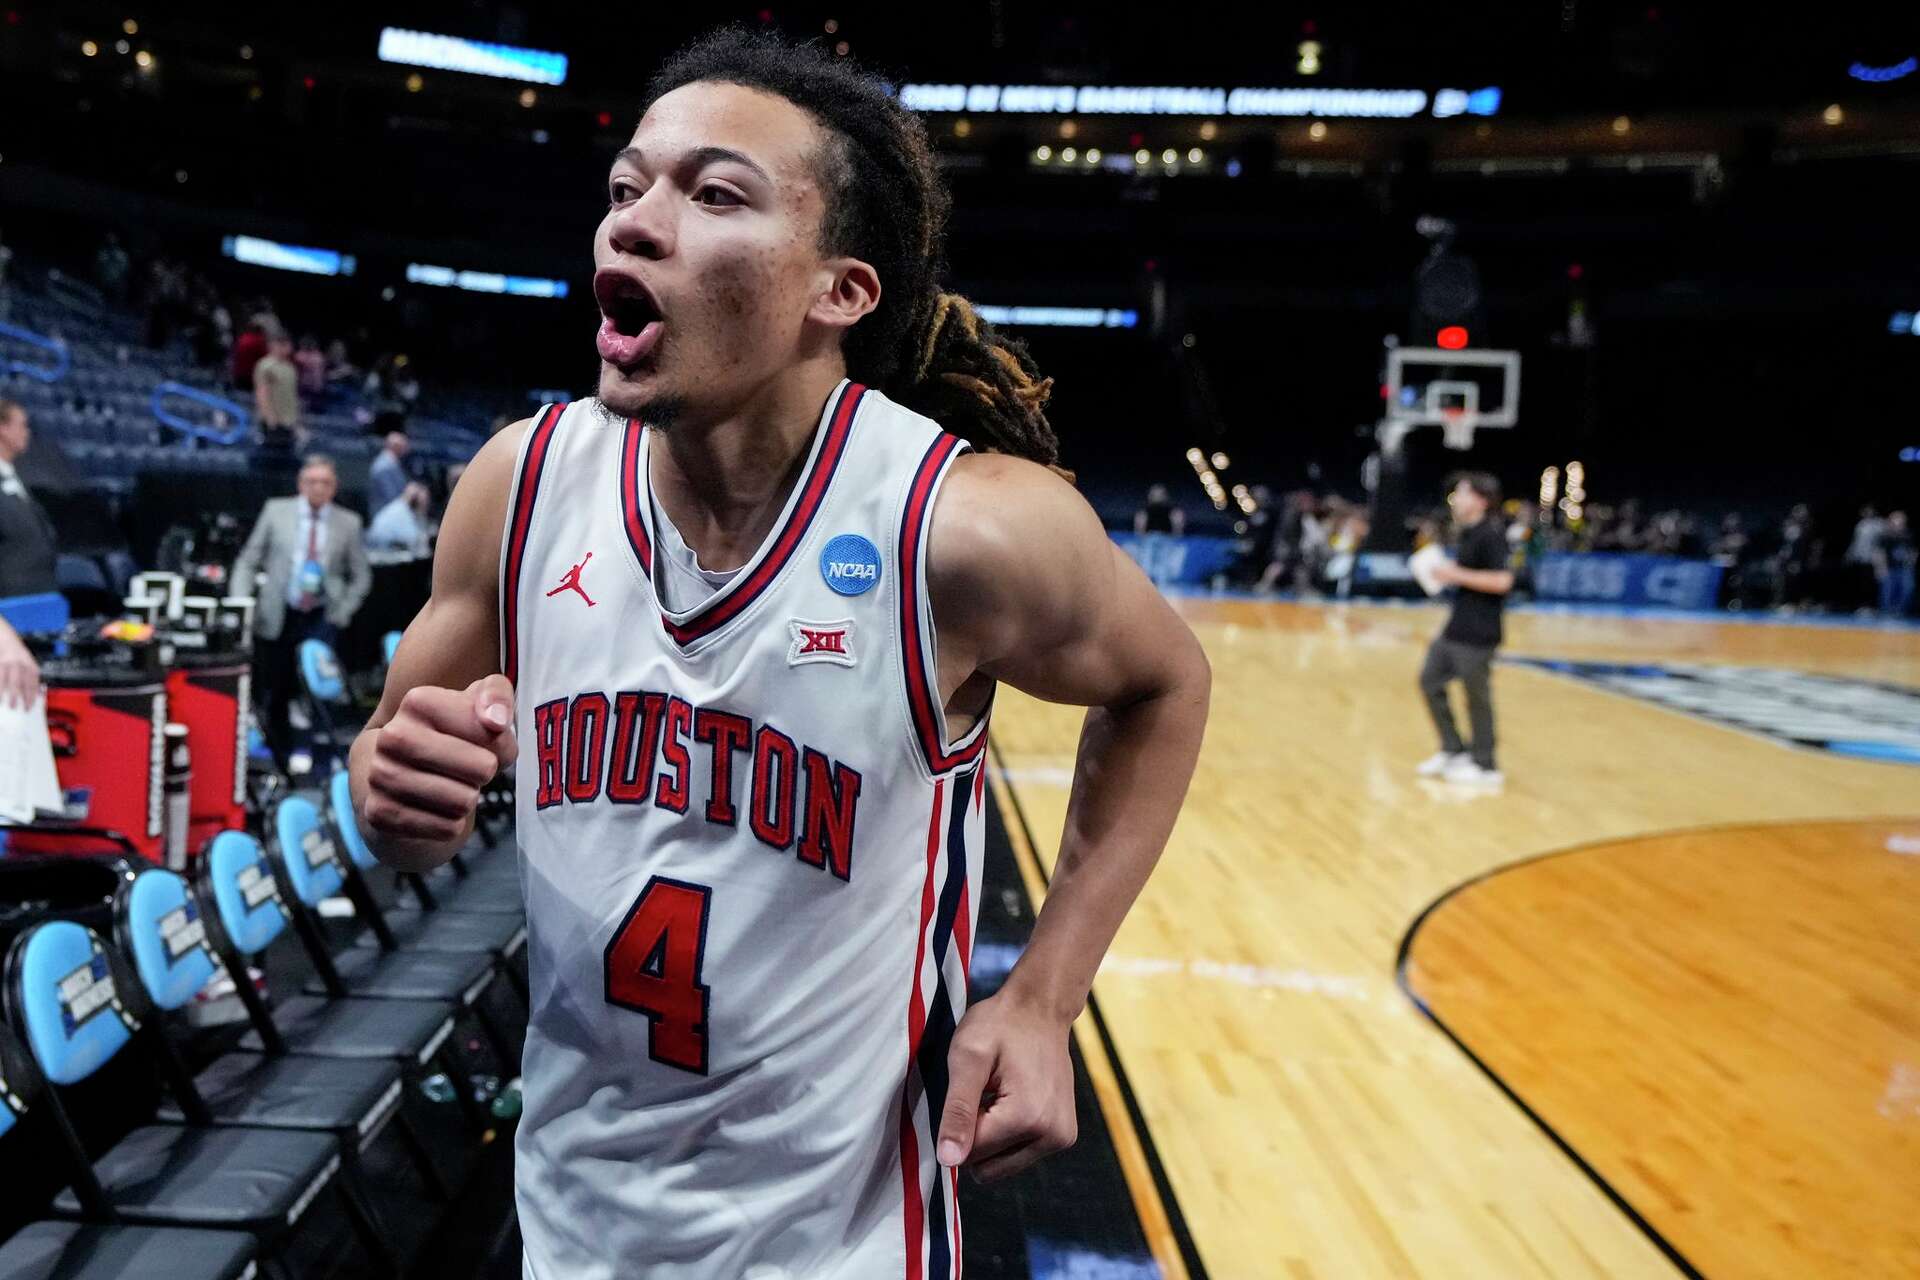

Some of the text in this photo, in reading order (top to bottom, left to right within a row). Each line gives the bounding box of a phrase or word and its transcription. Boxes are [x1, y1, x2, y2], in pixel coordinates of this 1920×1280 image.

[828, 561, 877, 580] NCAA
[800, 629, 846, 654] XII
[534, 691, 862, 882] HOUSTON
[603, 874, 712, 1076] 4
